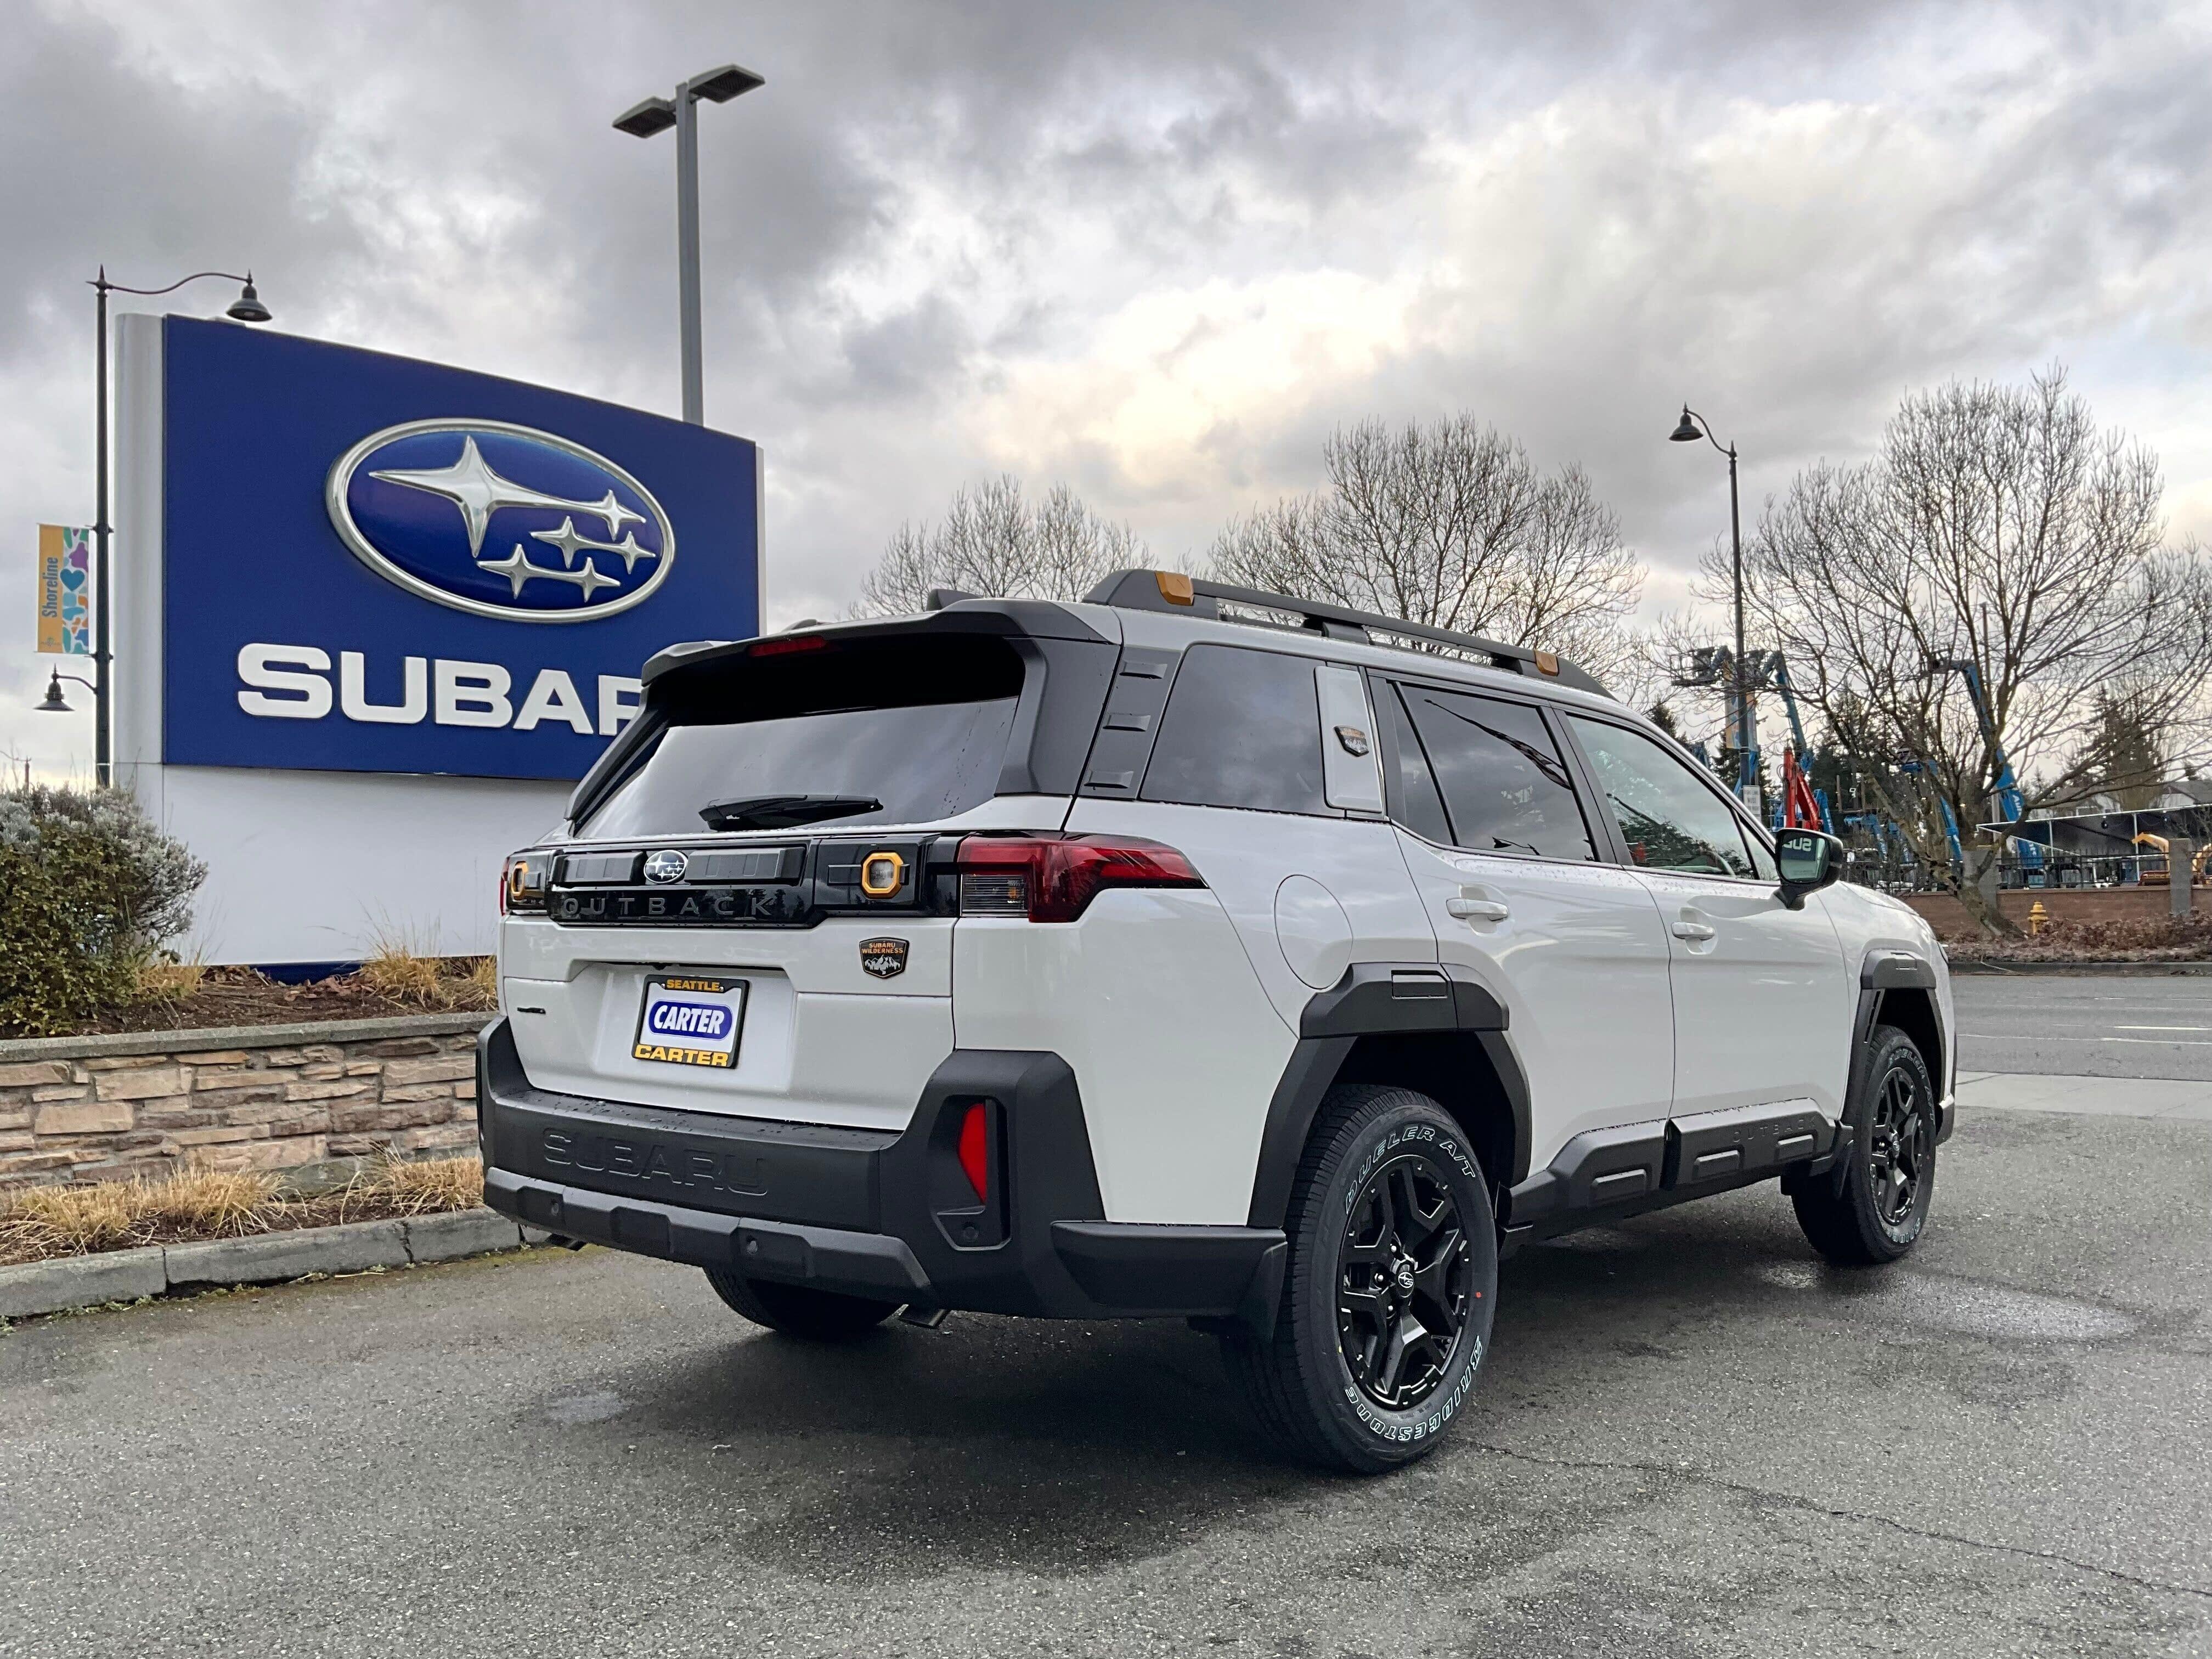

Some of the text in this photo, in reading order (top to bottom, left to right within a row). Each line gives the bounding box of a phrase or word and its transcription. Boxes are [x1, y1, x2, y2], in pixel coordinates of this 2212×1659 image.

[42, 557, 58, 618] Shoreline
[563, 896, 772, 916] OUTBACK
[666, 979, 720, 991] SEATTLE
[653, 1005, 725, 1034] CARTER
[635, 1044, 729, 1066] CARTER
[543, 1128, 768, 1196] SUBARU
[1345, 1126, 1476, 1215] DUELER A/T
[1345, 1335, 1483, 1442] BRIDGESTONE
